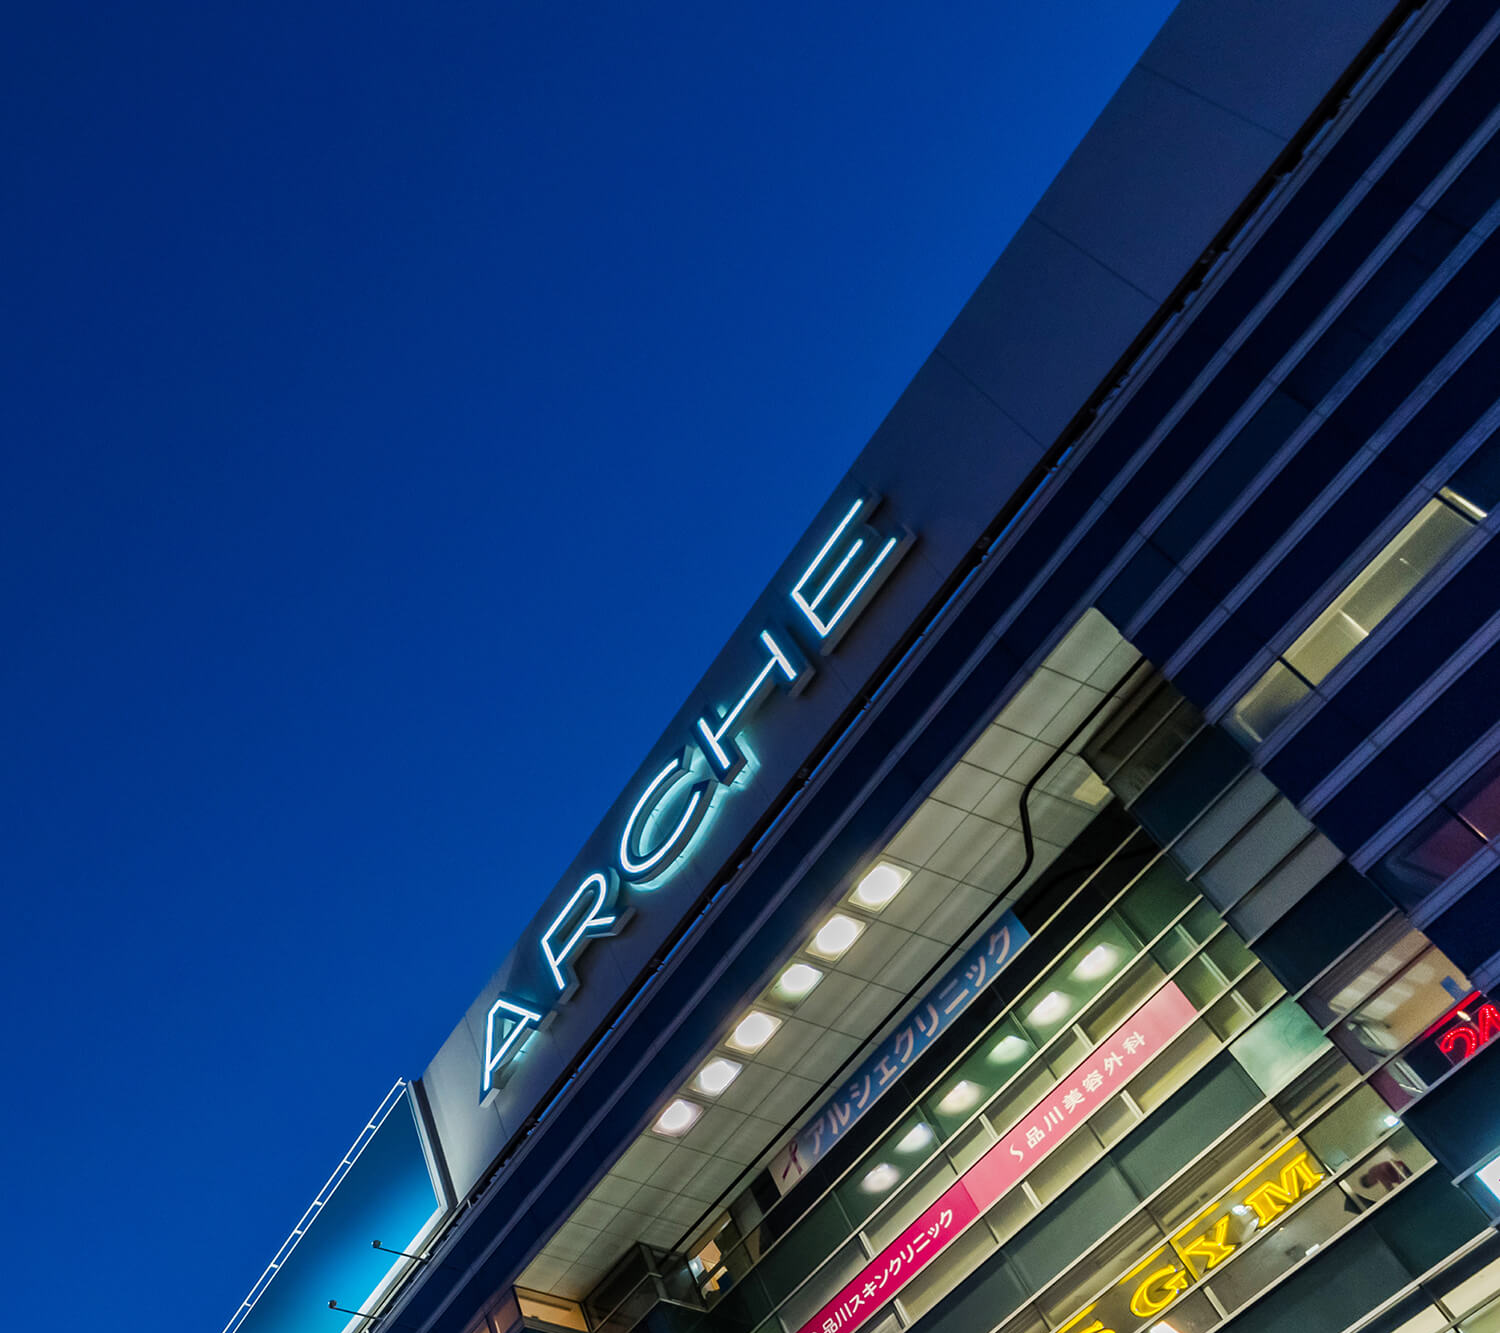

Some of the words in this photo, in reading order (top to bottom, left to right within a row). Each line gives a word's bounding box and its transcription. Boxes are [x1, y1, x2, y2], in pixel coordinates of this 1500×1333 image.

[481, 497, 905, 1098] ARCHE
[804, 926, 1010, 1155] アルシェクリニック
[1025, 1031, 1146, 1149] 品川美容外科
[1129, 1150, 1326, 1318] GYM
